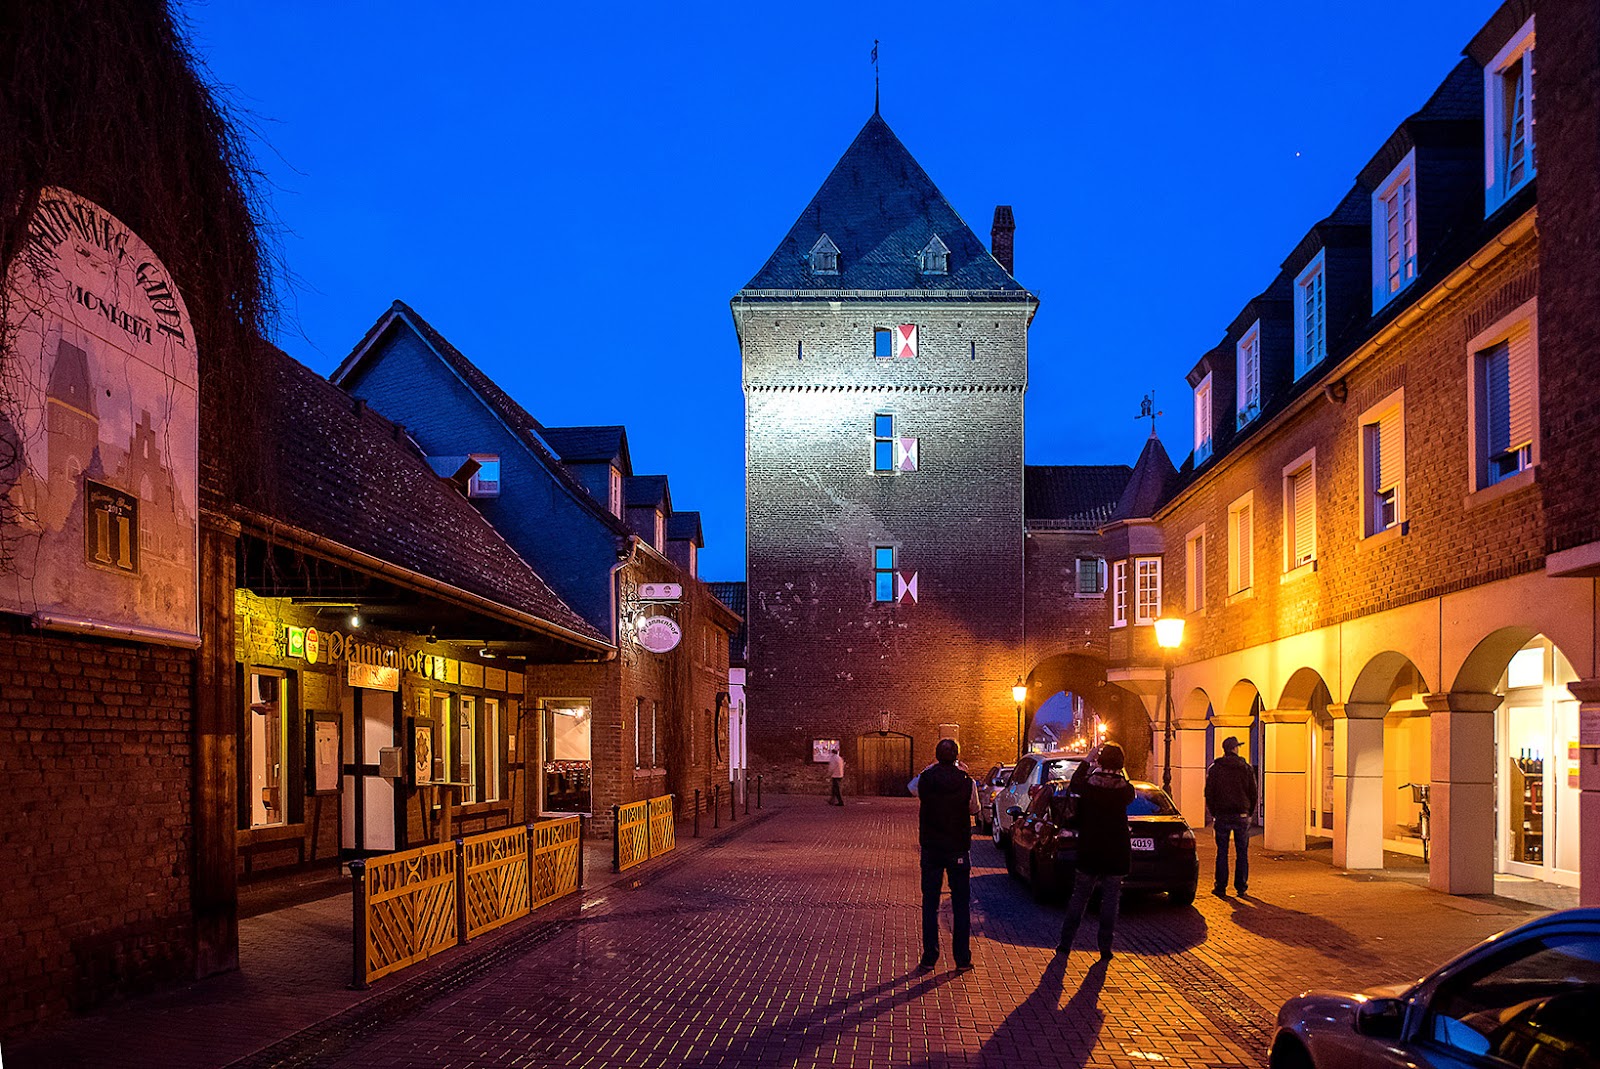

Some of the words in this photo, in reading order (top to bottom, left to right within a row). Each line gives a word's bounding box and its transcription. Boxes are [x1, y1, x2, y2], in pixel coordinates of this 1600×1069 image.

[66, 280, 153, 345] MONHEIM
[325, 631, 426, 676] Pfannenhof
[1131, 839, 1152, 848] 4019
